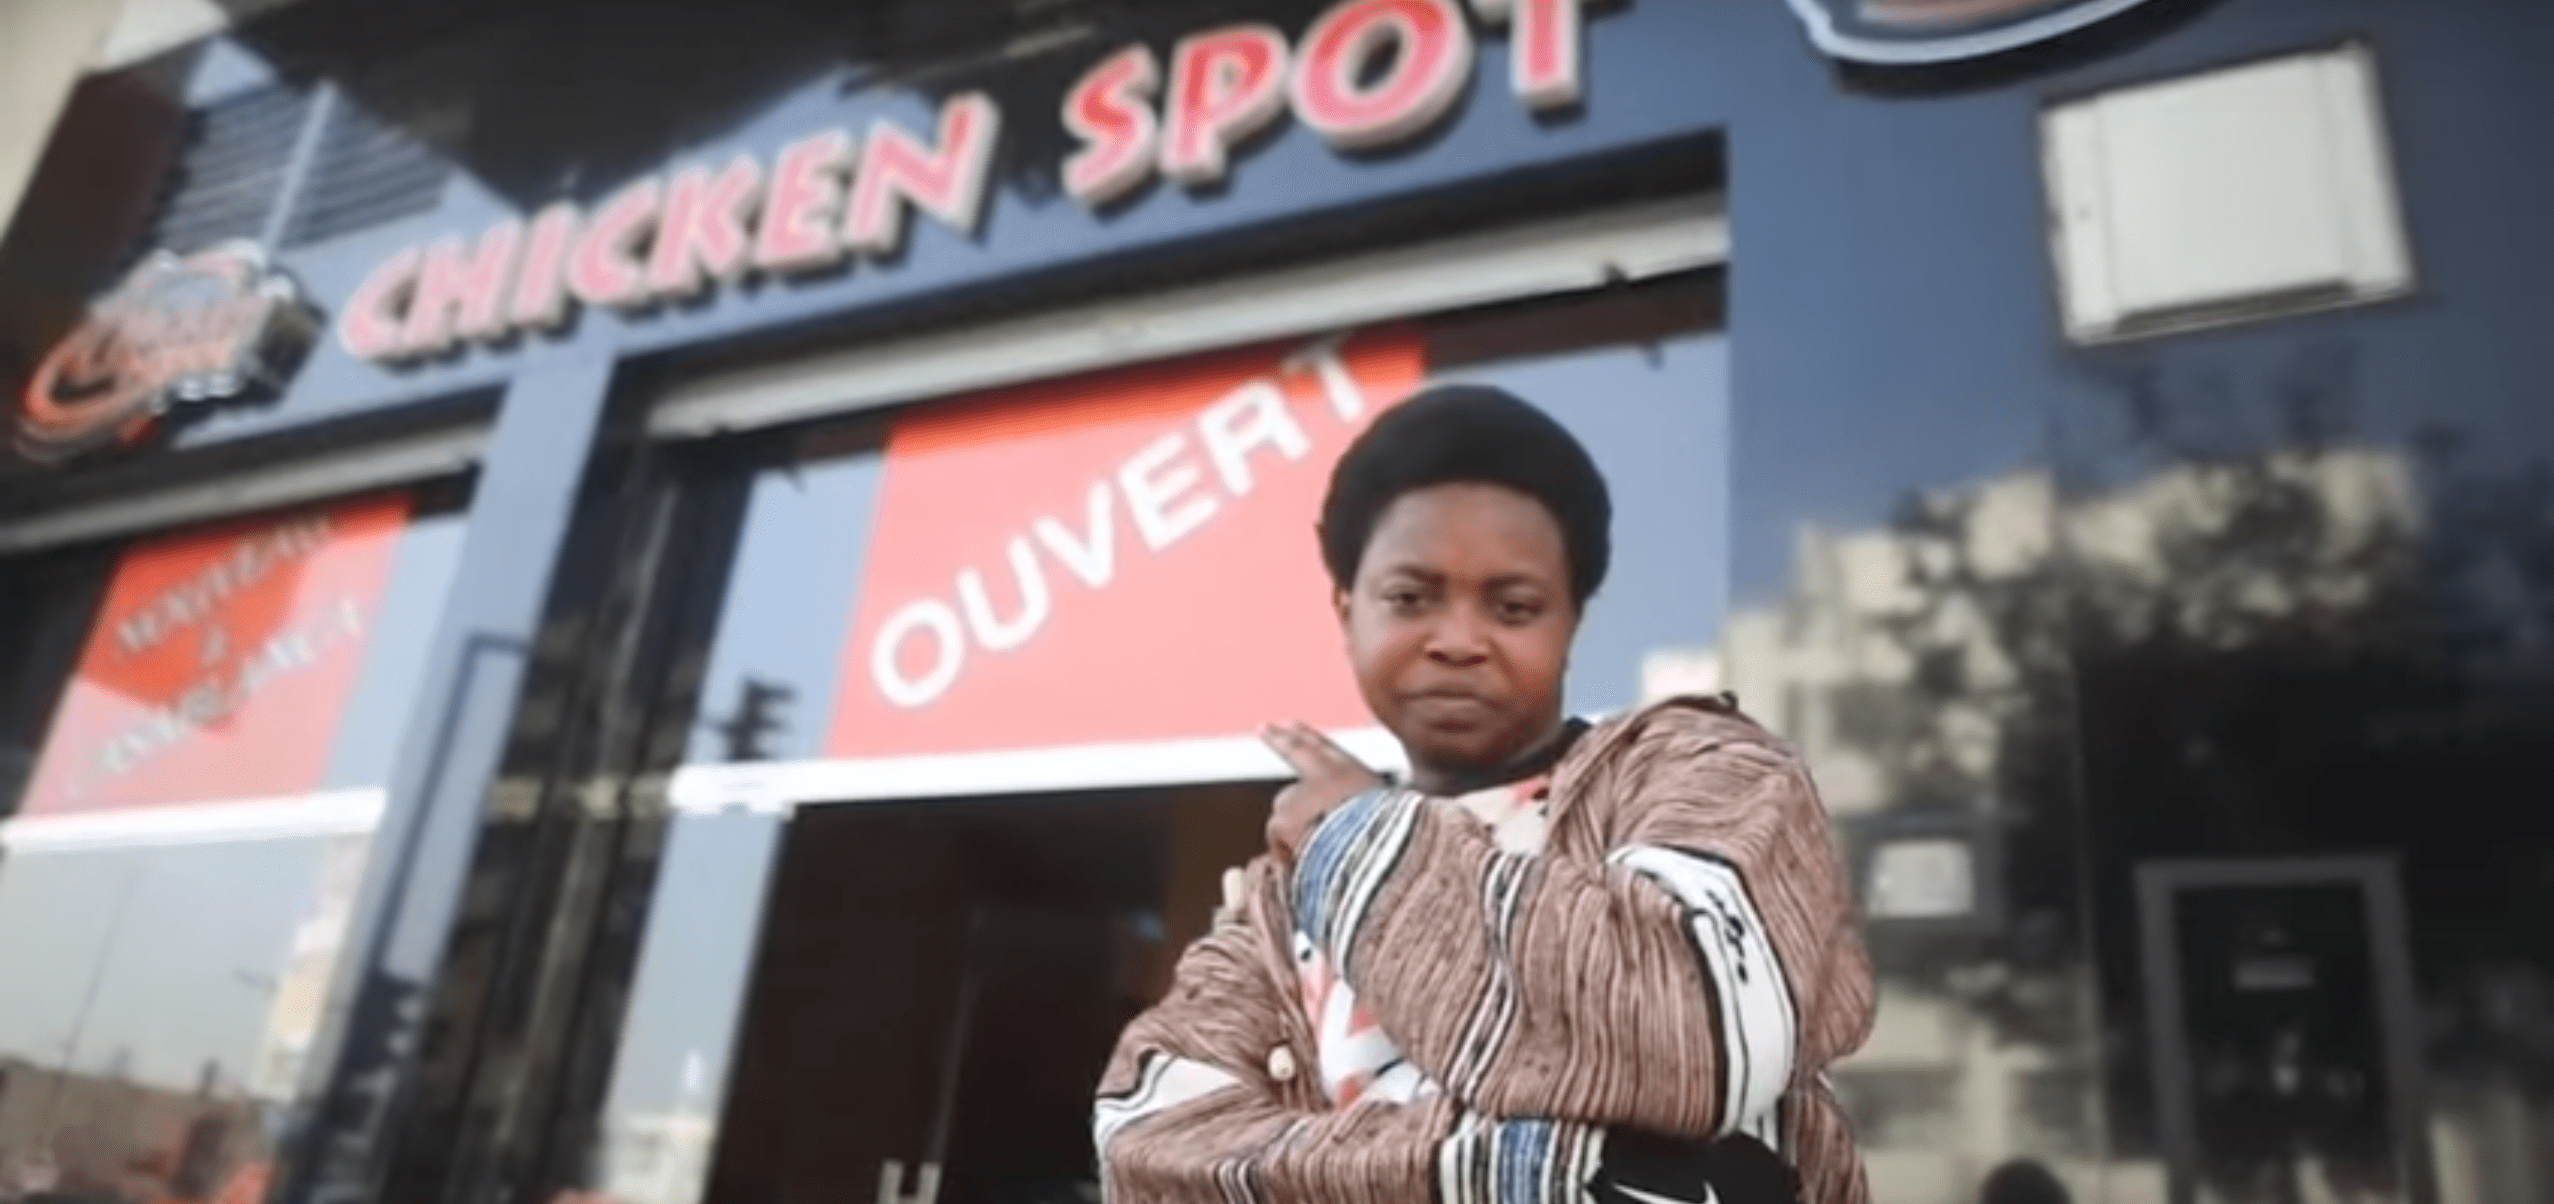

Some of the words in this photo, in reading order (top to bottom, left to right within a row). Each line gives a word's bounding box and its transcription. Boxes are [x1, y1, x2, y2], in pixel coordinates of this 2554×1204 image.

[337, 92, 1002, 360] CHICKEN
[1060, 0, 1582, 203] SPOT
[869, 340, 1368, 710] OUVERT
